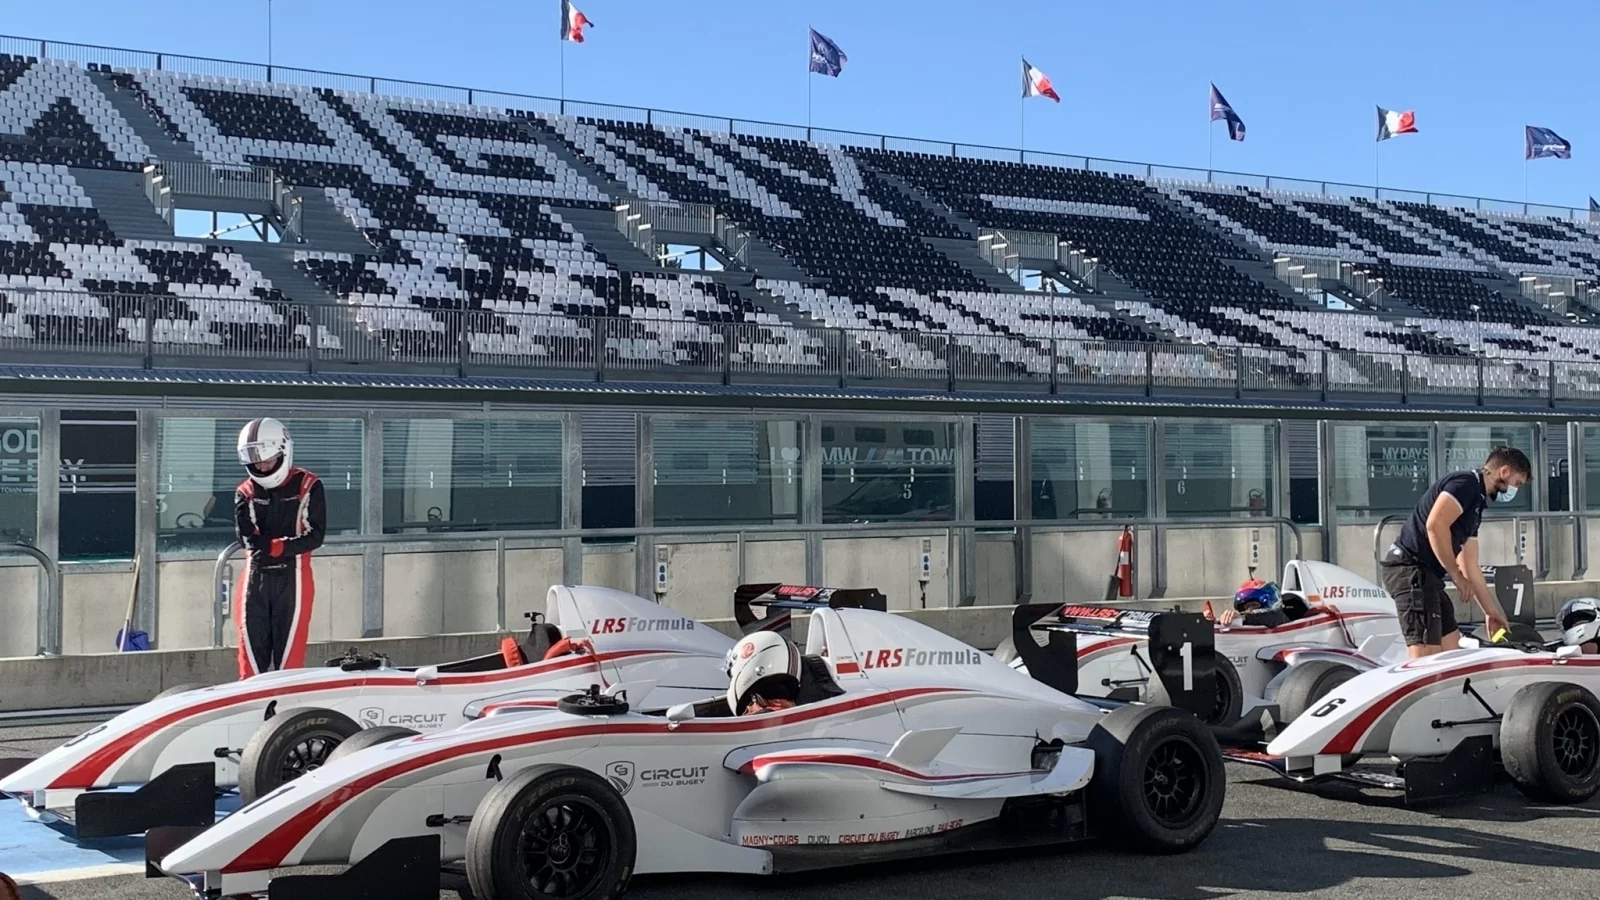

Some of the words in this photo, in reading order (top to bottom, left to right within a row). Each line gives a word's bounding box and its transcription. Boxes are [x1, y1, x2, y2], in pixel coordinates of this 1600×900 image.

[820, 447, 858, 465] MW
[1382, 447, 1399, 460] MY
[1400, 447, 1422, 460] DAY
[902, 484, 912, 499] 5
[1177, 480, 1186, 495] 6
[1512, 583, 1524, 616] 7
[591, 617, 695, 634] LRSFormula
[864, 648, 982, 669] LRSFormula
[1180, 642, 1193, 691] 1
[1310, 697, 1347, 717] 6
[388, 713, 447, 724] CIRCUIT
[640, 766, 709, 781] CIRCUIT
[676, 778, 705, 786] BUGEY
[742, 835, 799, 846] MAGNY-COURS
[880, 831, 900, 841] BUGEY
